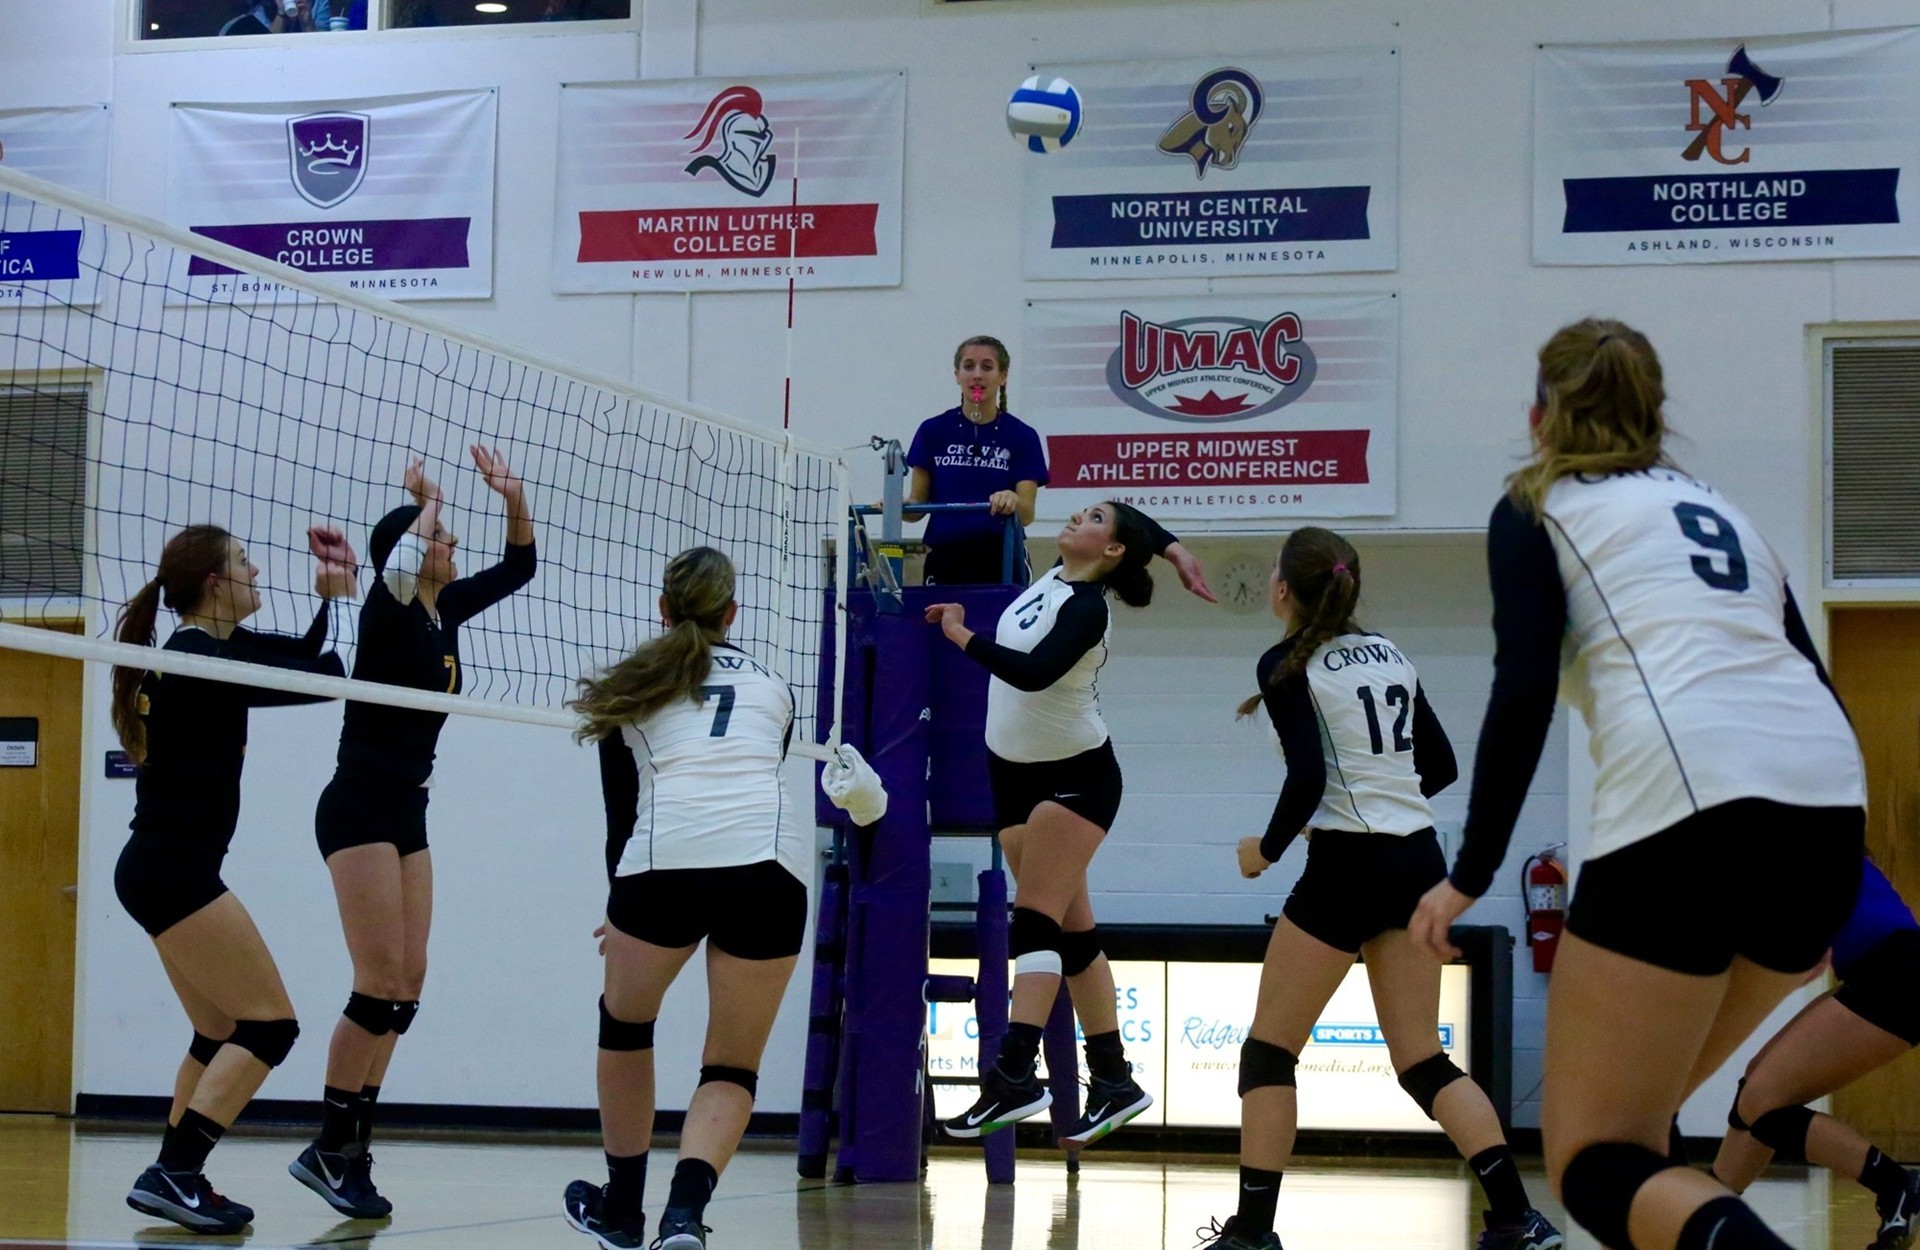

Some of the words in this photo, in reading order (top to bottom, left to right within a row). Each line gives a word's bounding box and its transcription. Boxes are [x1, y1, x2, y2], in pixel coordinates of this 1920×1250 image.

[1652, 179, 1807, 202] NORTHLAND
[1111, 200, 1190, 219] NORTH
[1199, 196, 1308, 217] CENTRAL
[1670, 201, 1788, 223] COLLEGE
[638, 215, 720, 234] MARTIN
[728, 212, 816, 232] LUTHER
[1139, 218, 1279, 240] UNIVERSITY
[286, 228, 364, 247] CROWN
[673, 234, 777, 253] COLLEGE
[1627, 238, 1719, 252] ASHLAND,
[1729, 235, 1835, 248] WISCONSIN
[276, 248, 374, 267] COLLEGE
[1090, 253, 1217, 266] MINNEAPOLIS,
[1225, 250, 1326, 262] MINNESOTA
[350, 278, 439, 289] MINNESOTA
[632, 269, 665, 279] NEW
[673, 268, 712, 279] ULM,
[211, 283, 233, 293] ST.
[1121, 309, 1303, 390] UMAC
[1144, 384, 1167, 398] UPPER
[1167, 376, 1198, 388] MIDWEST
[1200, 375, 1232, 383] ATHLETIC
[1232, 376, 1276, 395] CONFERENCE
[1116, 441, 1190, 459] UPPER
[1197, 438, 1299, 458] MIDWEST
[934, 455, 1009, 471] VOLLEYBALL
[1076, 462, 1181, 481] ATHLETIC
[1187, 459, 1339, 480] CONFERENCE
[1673, 502, 1749, 593] 9
[1323, 643, 1404, 672] CROWN
[700, 685, 736, 737] 7
[1356, 684, 1414, 755] 12
[1316, 1028, 1372, 1041] SPORTS
